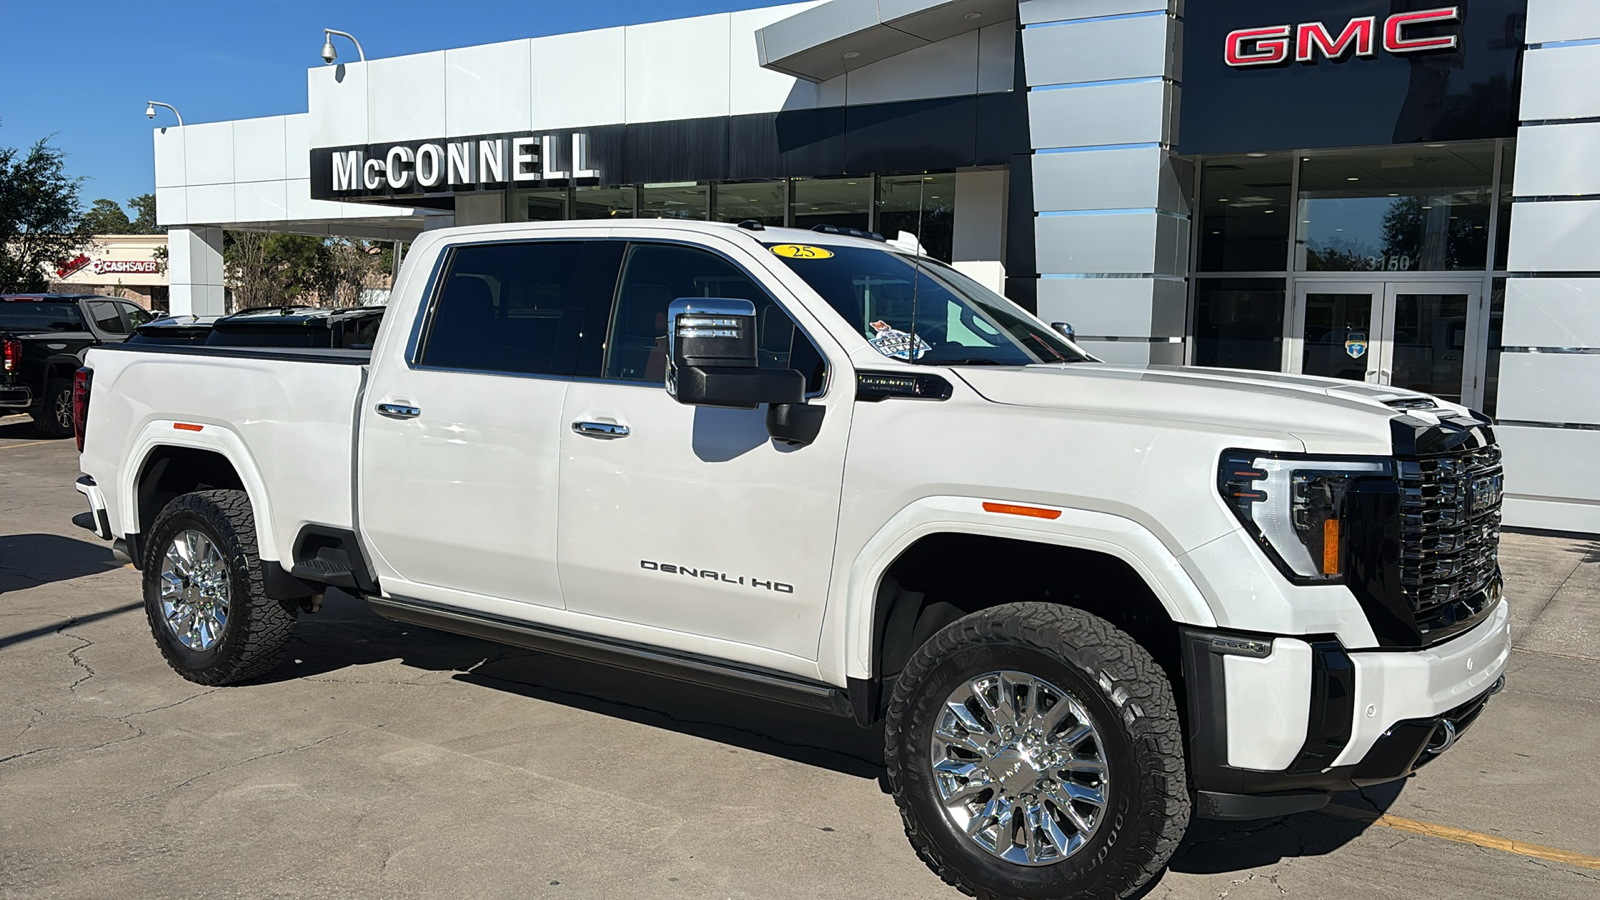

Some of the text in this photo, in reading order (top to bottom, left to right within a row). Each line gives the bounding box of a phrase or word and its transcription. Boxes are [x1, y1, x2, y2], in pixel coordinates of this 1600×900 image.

[1224, 6, 1458, 66] GMC
[332, 133, 599, 191] McCONNELL
[789, 246, 815, 257] 25
[1366, 255, 1410, 271] 3150
[640, 560, 794, 594] DENALI HD
